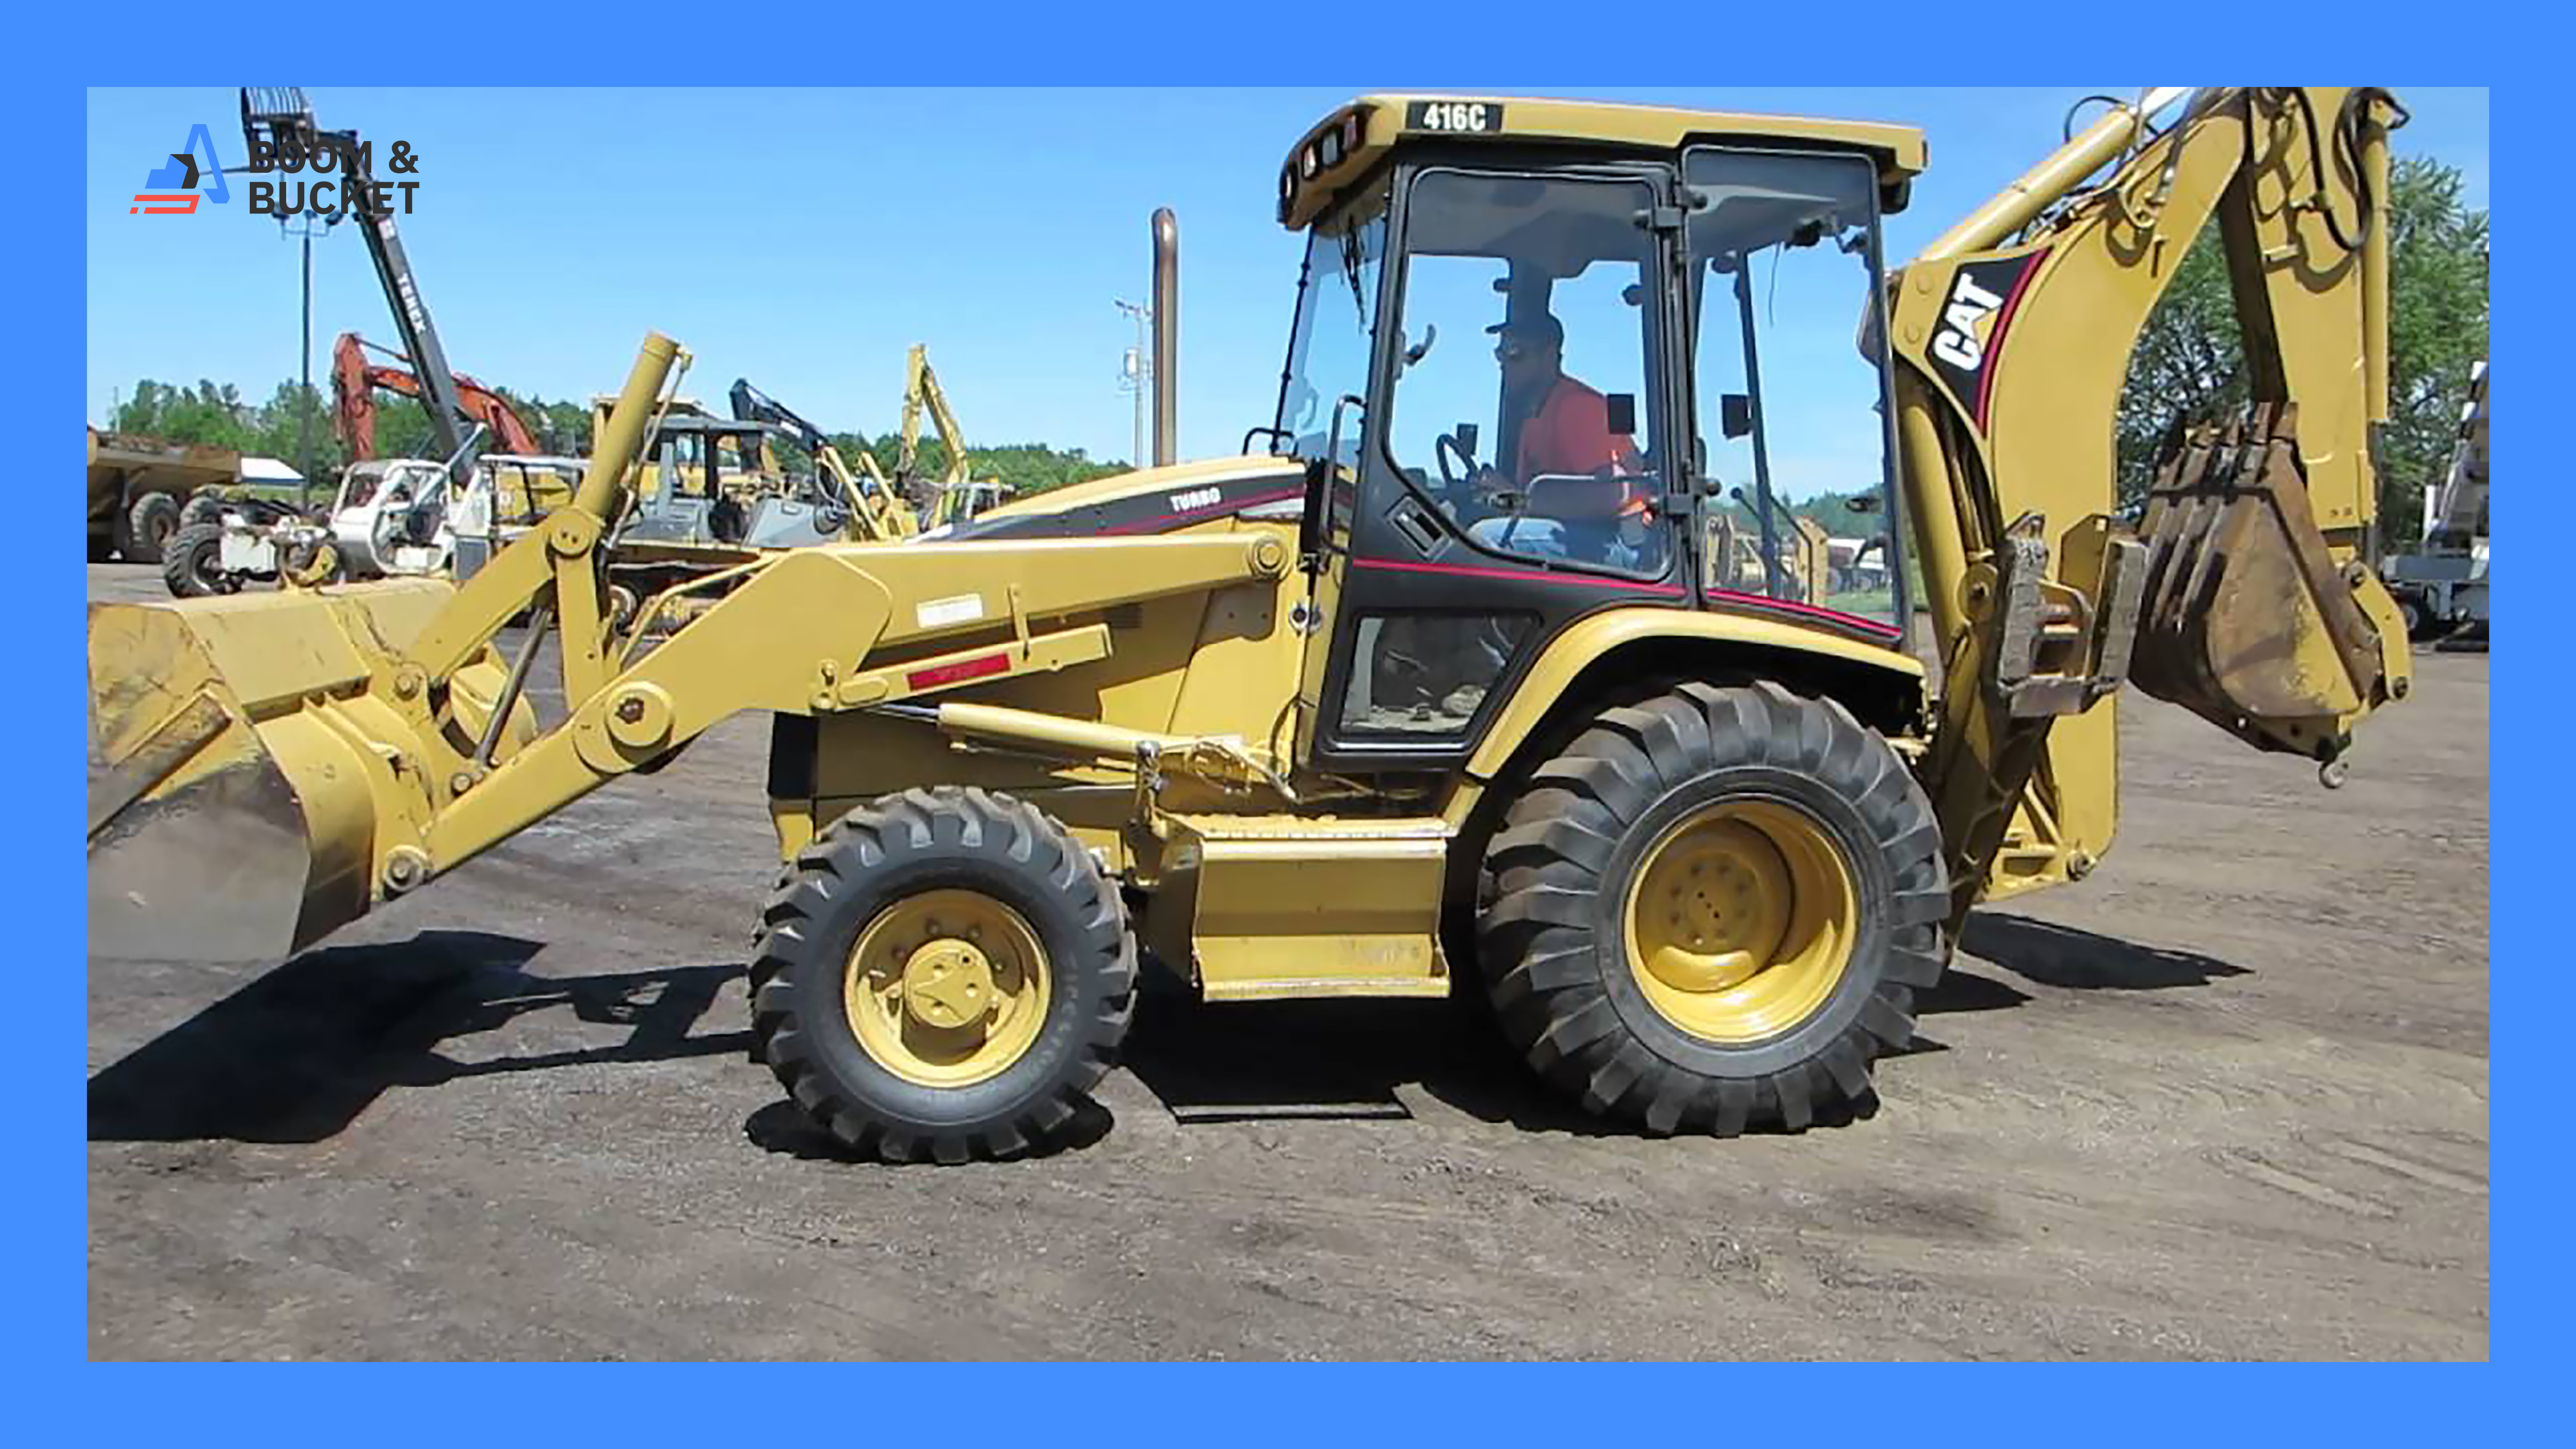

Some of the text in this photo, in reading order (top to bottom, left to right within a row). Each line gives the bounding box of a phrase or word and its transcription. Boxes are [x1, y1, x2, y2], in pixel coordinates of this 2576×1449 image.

[1424, 103, 1486, 131] 416C
[1935, 273, 2003, 371] CAT
[1170, 487, 1221, 511] TURBO
